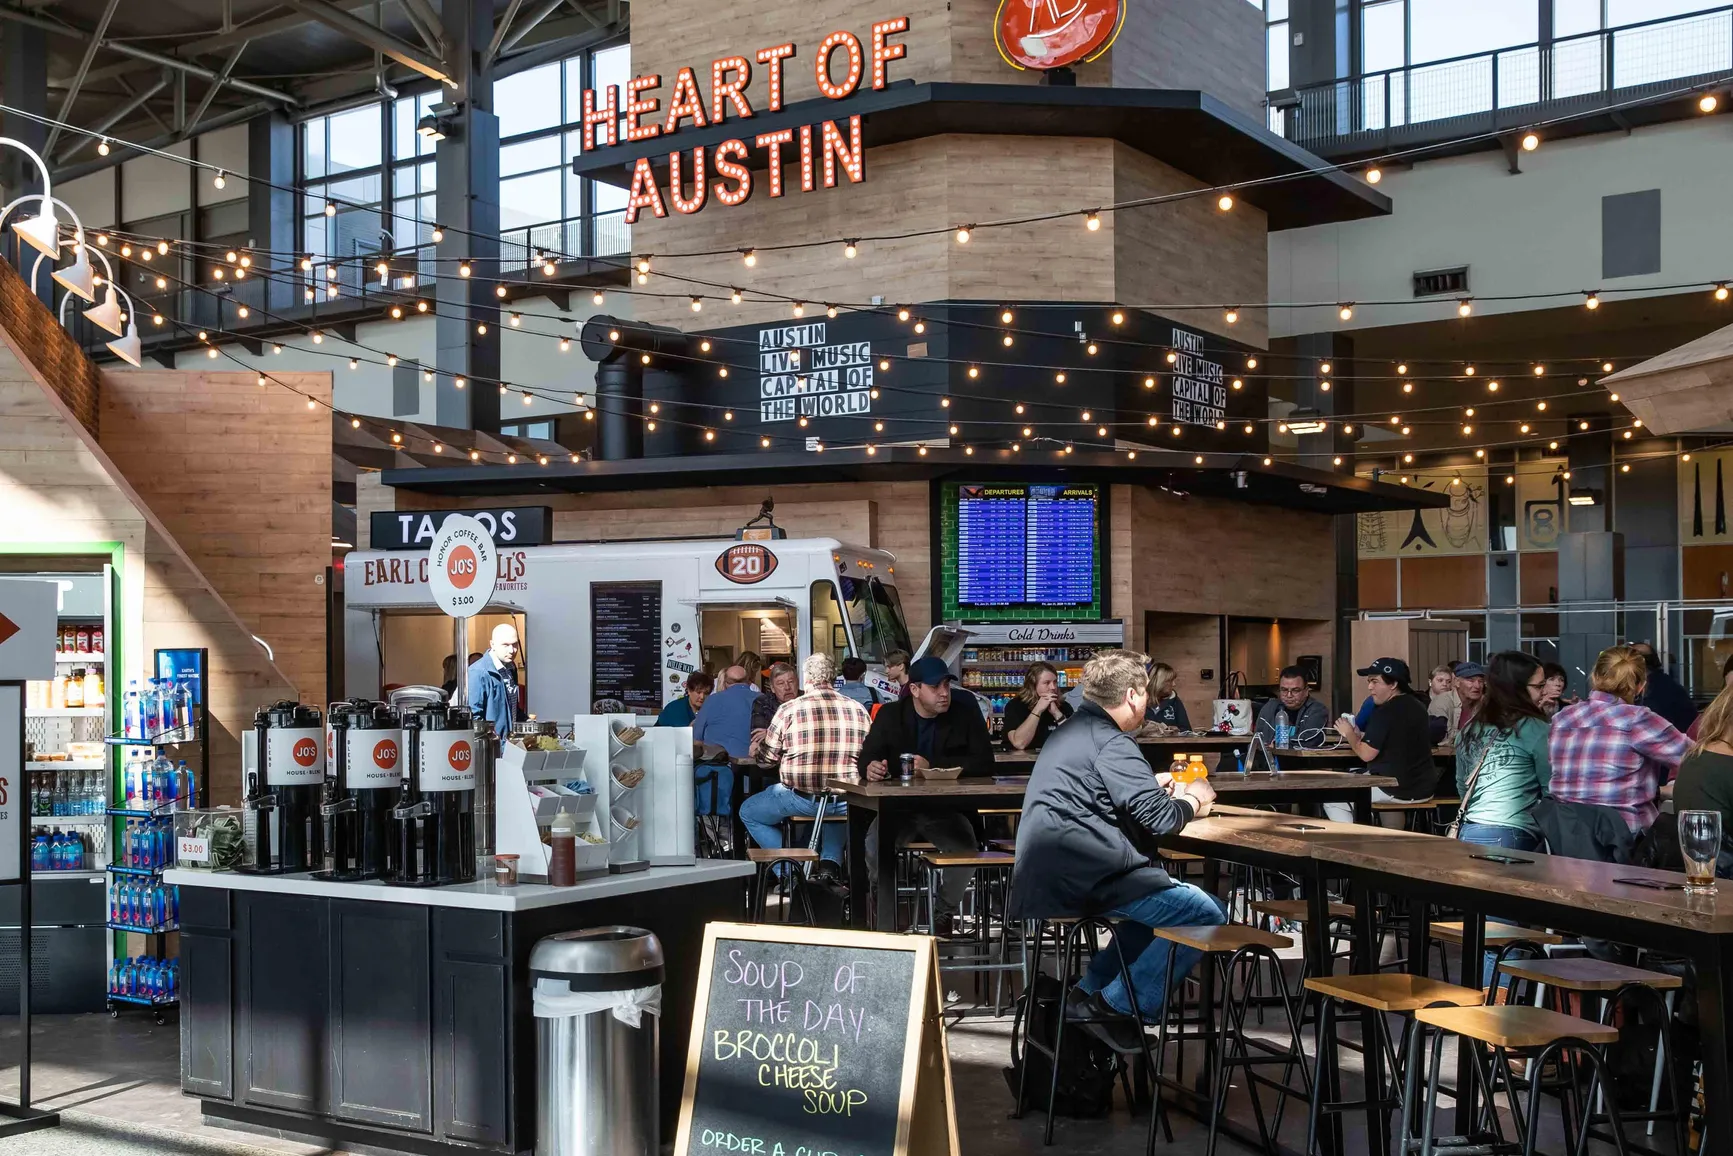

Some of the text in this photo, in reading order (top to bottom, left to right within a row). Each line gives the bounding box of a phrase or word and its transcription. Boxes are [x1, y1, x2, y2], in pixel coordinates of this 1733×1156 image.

[584, 16, 910, 151] HEART OF
[624, 115, 865, 224] AUSTIN
[760, 323, 825, 350] AUSTIN
[1173, 328, 1204, 356] AUSTIN
[761, 342, 870, 373] LIVE MUSIC
[1173, 353, 1223, 385] LIVE MUSIC
[848, 367, 872, 388] OF
[1173, 376, 1226, 408] CAPITAL OF
[761, 392, 869, 421] THE WORLD
[1173, 399, 1190, 422] THE
[398, 511, 517, 544] TAOS
[437, 529, 487, 567] HONOR COFFEE BAR
[364, 558, 415, 585] EARL
[451, 558, 474, 575] JO'S
[732, 556, 760, 575] 20
[495, 582, 528, 590] FAVORITES
[1008, 628, 1075, 641] Cold Drinks
[296, 746, 316, 757] JO'S
[376, 748, 397, 760] JO'S
[451, 750, 471, 761] JO'S
[182, 843, 203, 854] $3.00
[724, 949, 875, 999] SOUP OF
[737, 998, 791, 1025] THE
[714, 1030, 839, 1069] BROCCOLI
[758, 1064, 838, 1090] CHEESE
[802, 1089, 868, 1117] SOUP
[701, 1129, 766, 1155] ORDER
[772, 1142, 786, 1156] A
